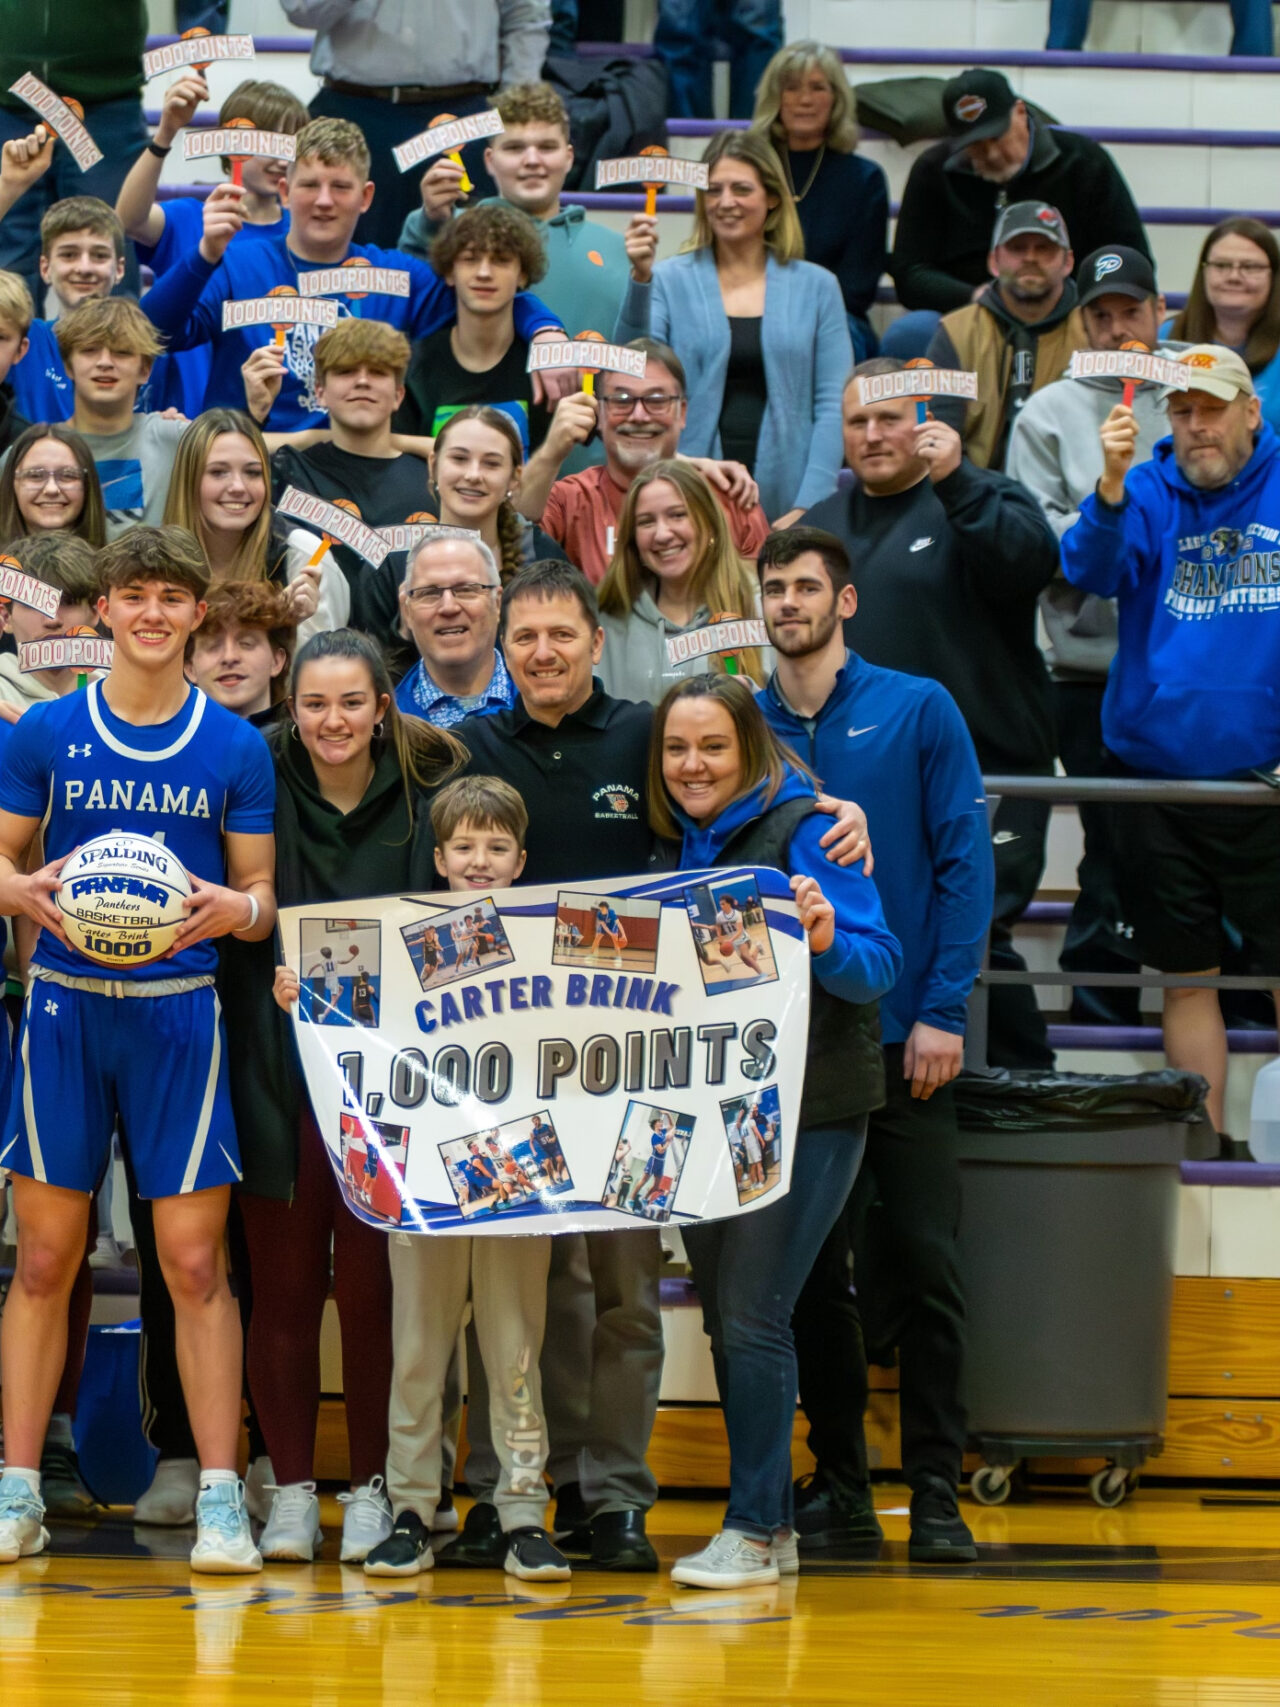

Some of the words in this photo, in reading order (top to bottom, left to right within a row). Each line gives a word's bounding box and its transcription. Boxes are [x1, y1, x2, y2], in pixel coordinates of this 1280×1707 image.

[145, 46, 183, 75] 1000
[186, 36, 253, 60] POINTS
[16, 75, 55, 112] 1000
[47, 102, 99, 170] POINTS
[186, 131, 224, 157] 1000
[227, 130, 296, 158] POINTS
[399, 134, 436, 166] 1000
[439, 112, 503, 144] POINTS
[598, 160, 639, 186] 1000
[642, 159, 709, 184] POINTS
[301, 270, 342, 294] 1000
[345, 269, 409, 293] POINTS
[225, 299, 268, 326] 1000
[271, 299, 337, 325] POINTS
[530, 344, 574, 368] 1000
[578, 343, 645, 376] POINTS
[1075, 352, 1117, 376] 1000
[1122, 353, 1188, 386] POINTS
[863, 371, 907, 402] 1000
[910, 369, 977, 397] POINTS
[282, 489, 326, 526] 1000
[325, 509, 391, 566] POINTS
[21, 643, 67, 670] 1000
[668, 630, 713, 663] 1000
[65, 779, 211, 818] PANAMA
[592, 784, 639, 801] PANAMA
[79, 847, 168, 875] SPALDING
[71, 877, 169, 908] PANAMA
[94, 896, 140, 911] Panthers
[76, 907, 161, 926] BASKETBALL
[77, 922, 111, 938] Carter
[115, 929, 149, 940] Brink
[84, 935, 152, 957] 1000
[414, 975, 553, 1034] CARTER
[566, 973, 680, 1017] BRINK
[337, 1040, 512, 1117] 1,000
[536, 1018, 778, 1100] POINTS
